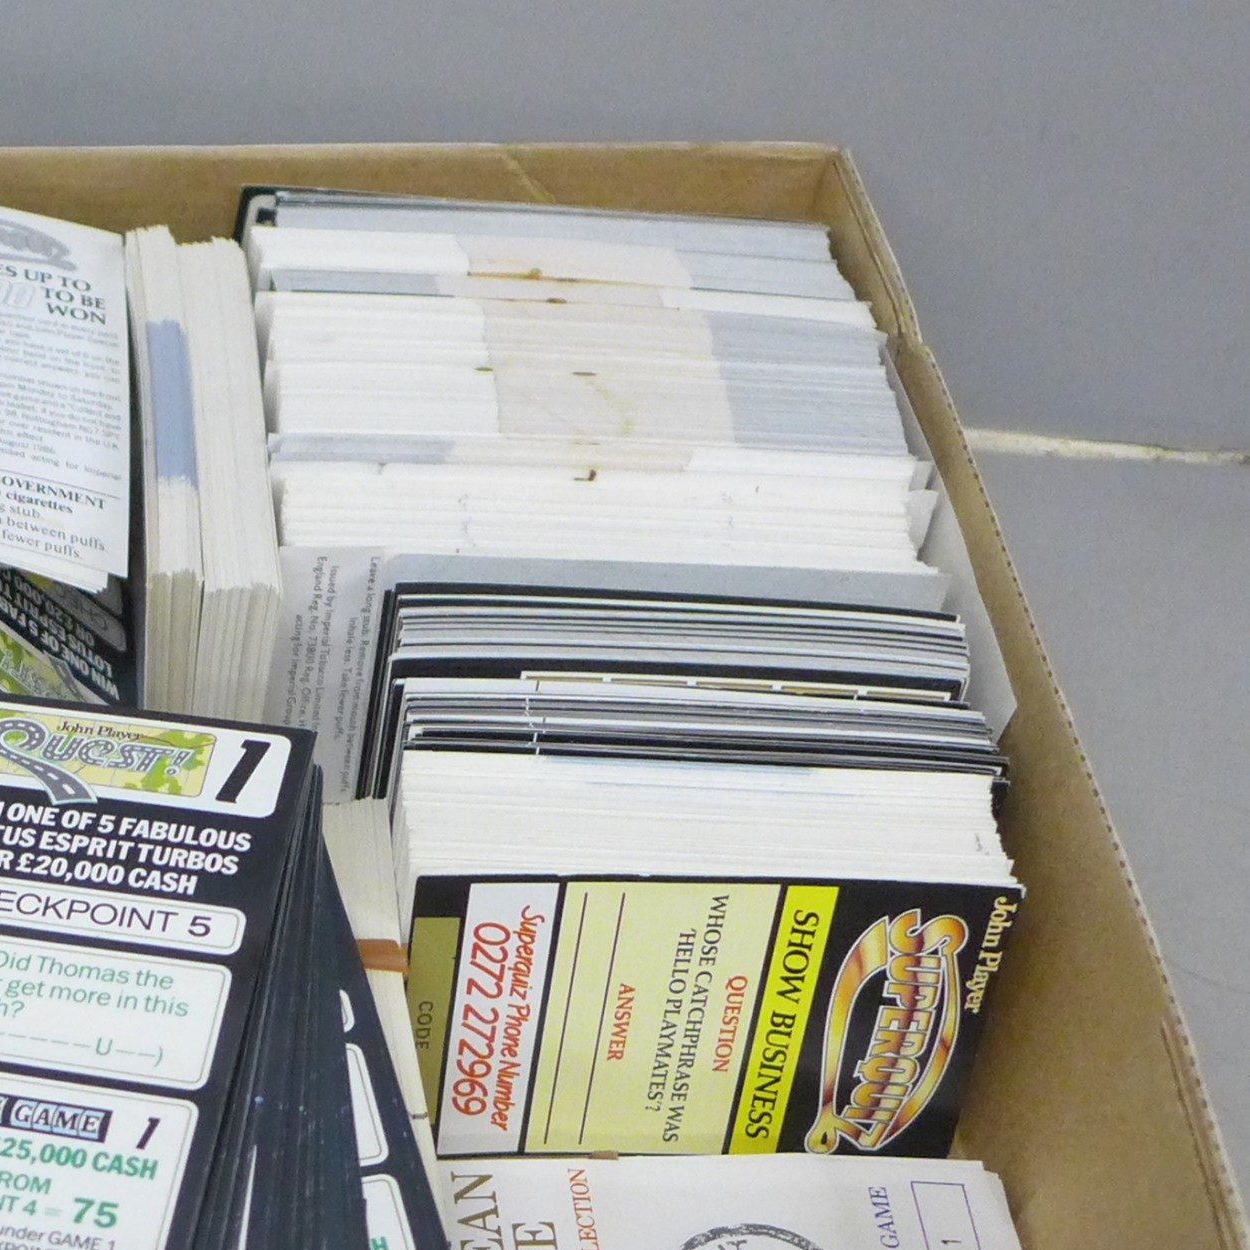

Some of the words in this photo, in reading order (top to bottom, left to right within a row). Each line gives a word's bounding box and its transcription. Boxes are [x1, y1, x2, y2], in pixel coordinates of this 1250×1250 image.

[24, 270, 52, 284] UP
[57, 276, 91, 291] TO
[47, 303, 107, 325] WON
[215, 739, 271, 805] 1
[7, 803, 59, 826] ONE
[61, 810, 96, 830] OF
[97, 815, 116, 833] 5
[119, 818, 251, 852] FABULOUS
[189, 916, 211, 937] 5
[701, 895, 730, 966] WHOSE
[982, 896, 1018, 948] John
[38, 956, 130, 985] Thomas
[136, 970, 174, 990] the
[465, 922, 510, 999] 0272
[776, 909, 819, 1004] SHOW
[963, 950, 1003, 1014] Player
[414, 1001, 433, 1050] CODE
[606, 983, 635, 1061] ANSWER
[671, 971, 714, 1101] CATCHPHRASE
[713, 974, 748, 1073] QUESTION
[804, 907, 969, 1154] SUPERQUIZ
[451, 1004, 500, 1116] 272969
[745, 1011, 796, 1139] BUSINESS
[14, 1101, 101, 1134] GAME
[663, 1106, 686, 1142] WAS
[71, 1197, 119, 1229] 75
[868, 1186, 899, 1247] GAME
